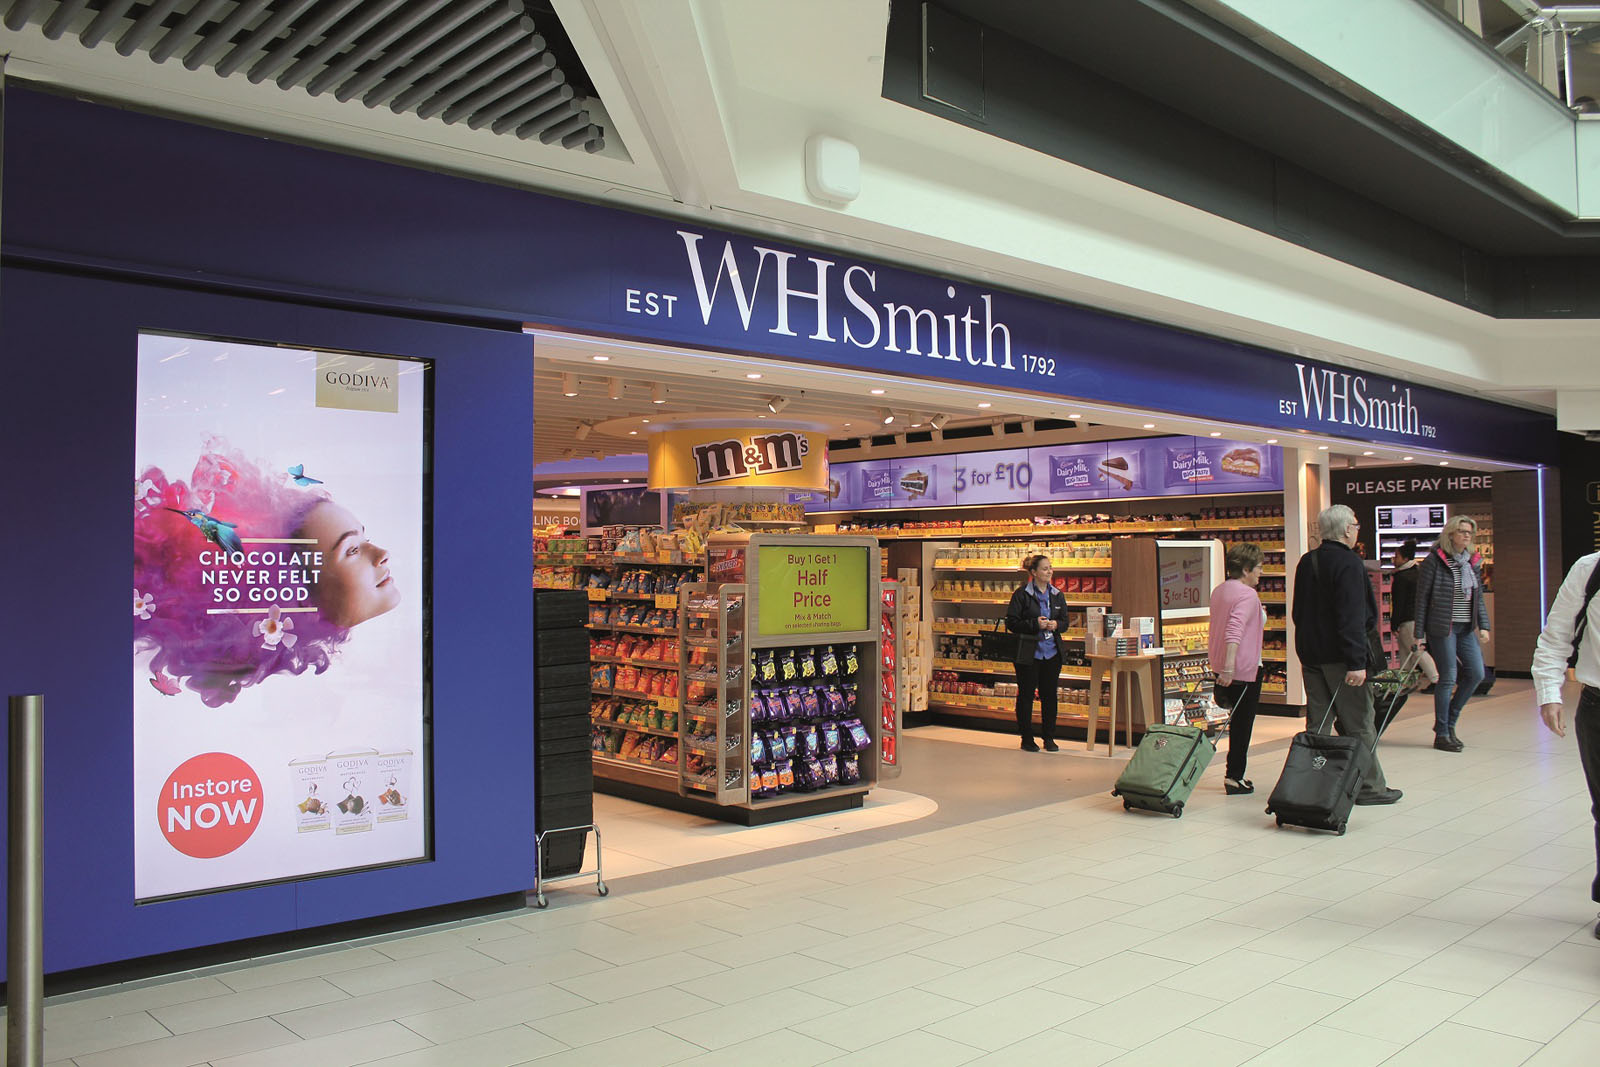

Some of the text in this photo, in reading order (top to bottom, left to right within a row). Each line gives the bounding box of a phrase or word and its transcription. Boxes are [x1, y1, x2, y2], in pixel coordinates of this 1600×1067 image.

[626, 229, 1056, 377] EST WHSmith 1792
[326, 371, 389, 389] GODIVA
[1279, 363, 1436, 438] EST WHSmith 1792
[1056, 464, 1088, 476] Dairy Milk
[1172, 456, 1211, 469] Dairy Milk
[952, 462, 1033, 492] 3 for £10
[1346, 475, 1493, 495] PLEASE PAY HERE
[563, 516, 580, 526] BO
[199, 551, 323, 567] CHOCOLATE
[787, 554, 837, 565] Buy 1 Get 1
[202, 569, 321, 585] NEVER FELT
[797, 569, 829, 586] Half
[213, 587, 309, 602] SO GOOD
[793, 591, 831, 608] Price
[1163, 587, 1200, 605] 3 for £10
[807, 613, 811, 621] &
[298, 765, 327, 774] GODIVA
[337, 759, 369, 769] GODIVA
[377, 758, 405, 767] GODIVA
[172, 778, 253, 800] Instore
[167, 797, 257, 833] NOW
